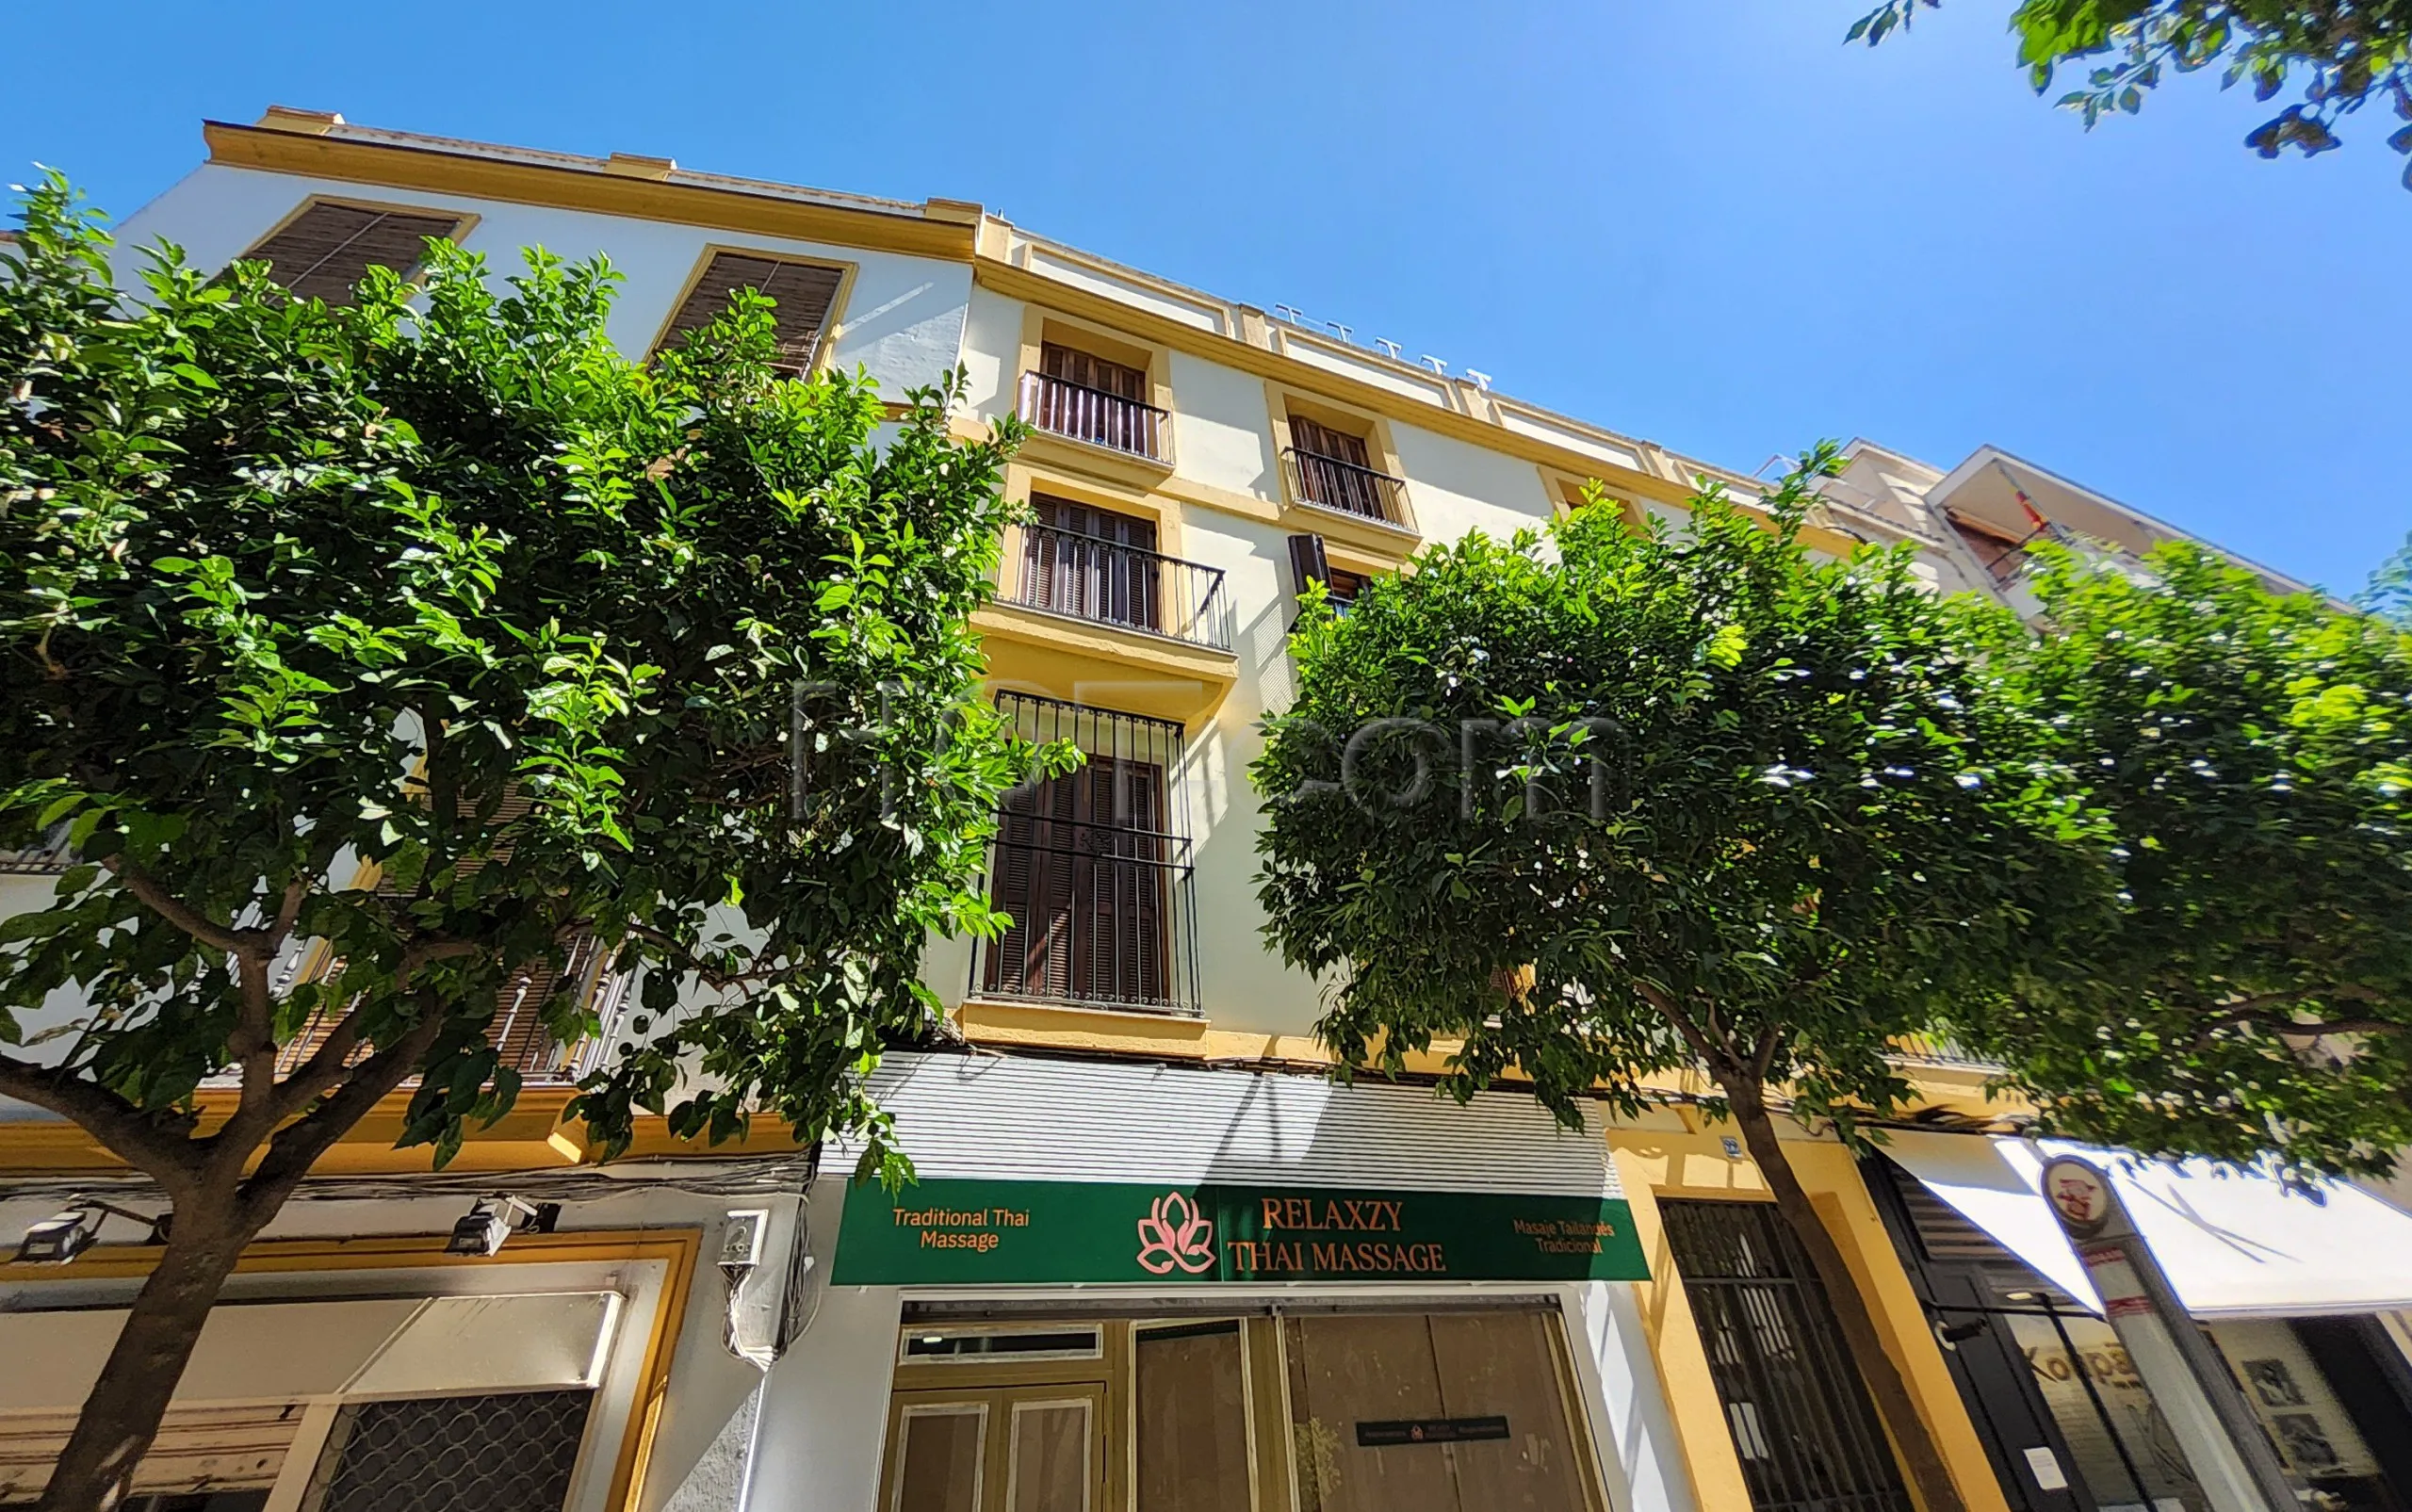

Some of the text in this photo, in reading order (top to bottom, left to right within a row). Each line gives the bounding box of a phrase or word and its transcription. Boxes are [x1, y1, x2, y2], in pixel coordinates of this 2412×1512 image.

[892, 1208, 1030, 1227] Traditional Thai
[1261, 1197, 1404, 1231] RELAXZY
[1512, 1219, 1556, 1238] Masaje
[920, 1229, 1000, 1252] Massage
[1534, 1237, 1604, 1254] Tradicional
[1227, 1241, 1447, 1273] THAI MASSAGE
